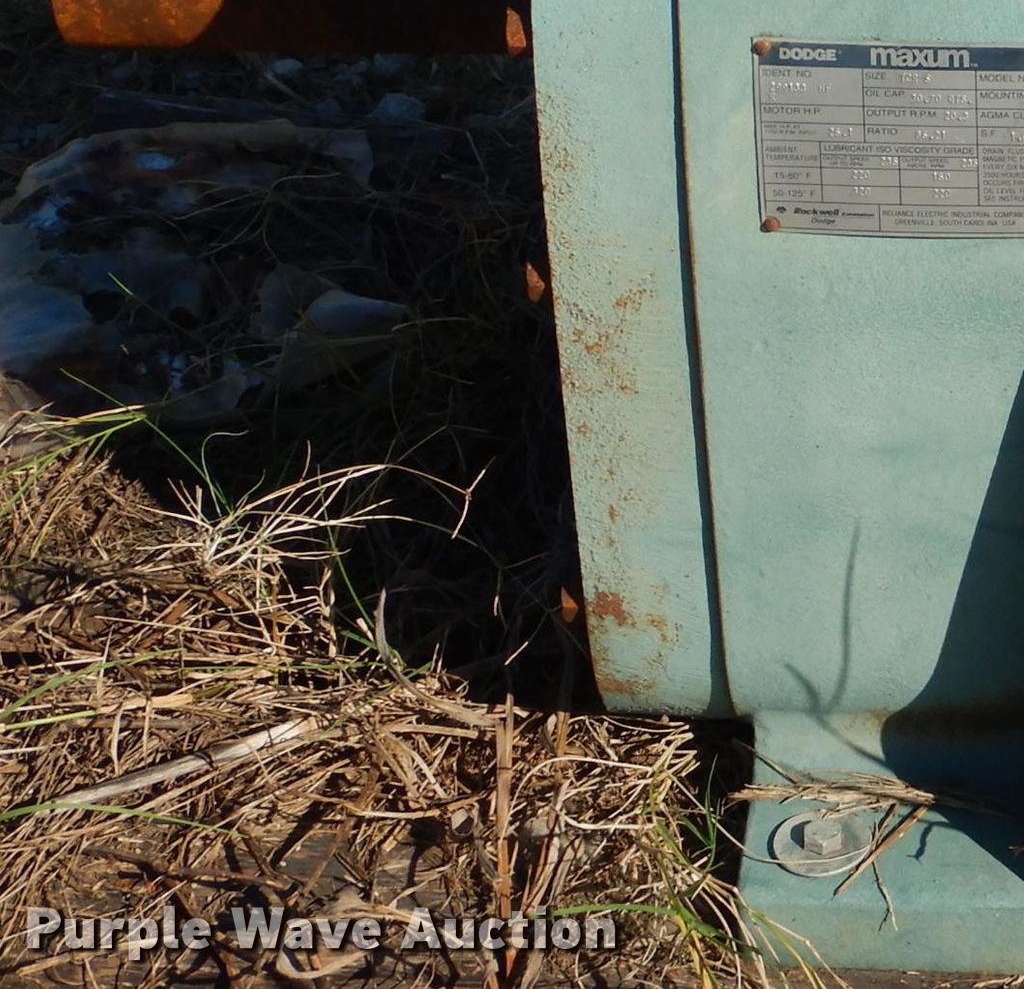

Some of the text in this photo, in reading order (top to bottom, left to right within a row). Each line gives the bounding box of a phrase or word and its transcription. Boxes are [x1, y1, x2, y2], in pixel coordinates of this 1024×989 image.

[779, 47, 837, 61] DODGE
[870, 47, 970, 68] maxum
[761, 69, 791, 77] IDENT
[865, 72, 886, 80] SIZE
[980, 74, 1016, 83] MODEL
[865, 89, 880, 98] OIL
[763, 106, 800, 115] MOTOR
[866, 109, 906, 118] OUTPUT
[980, 111, 1010, 119] AGMA
[867, 127, 898, 136] RATIO
[823, 144, 874, 153] LUBRICANT
[895, 146, 940, 154] VISCOSITY
[943, 147, 975, 155] GRADE
[766, 154, 818, 162] TEMPERATURE
[793, 207, 840, 216] Rockwell
